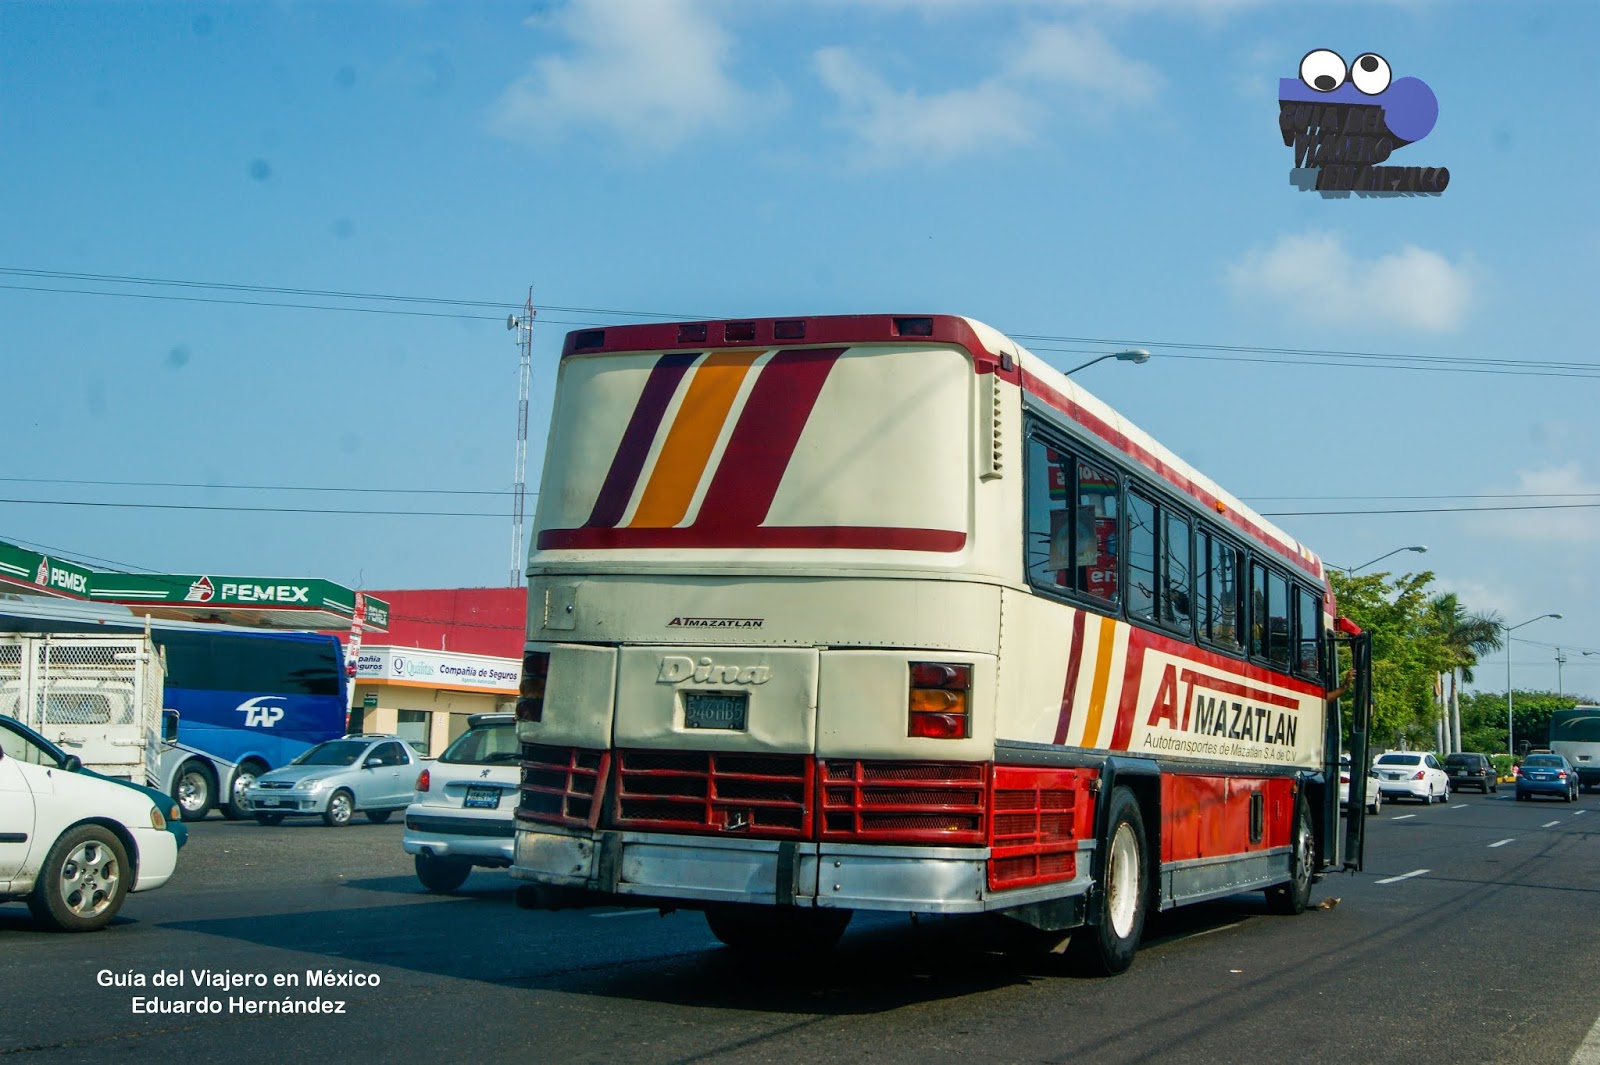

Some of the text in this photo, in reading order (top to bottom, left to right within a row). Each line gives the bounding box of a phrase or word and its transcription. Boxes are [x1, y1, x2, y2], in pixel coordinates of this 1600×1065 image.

[50, 567, 88, 593] PEMEX
[221, 583, 309, 602] PEMEX
[478, 668, 487, 677] de
[489, 669, 517, 680] Seguros
[656, 655, 773, 685] Dina
[235, 696, 287, 727] TAP
[1144, 733, 1217, 755] Autotransportes
[1219, 742, 1230, 755] de
[1277, 752, 1285, 760] de
